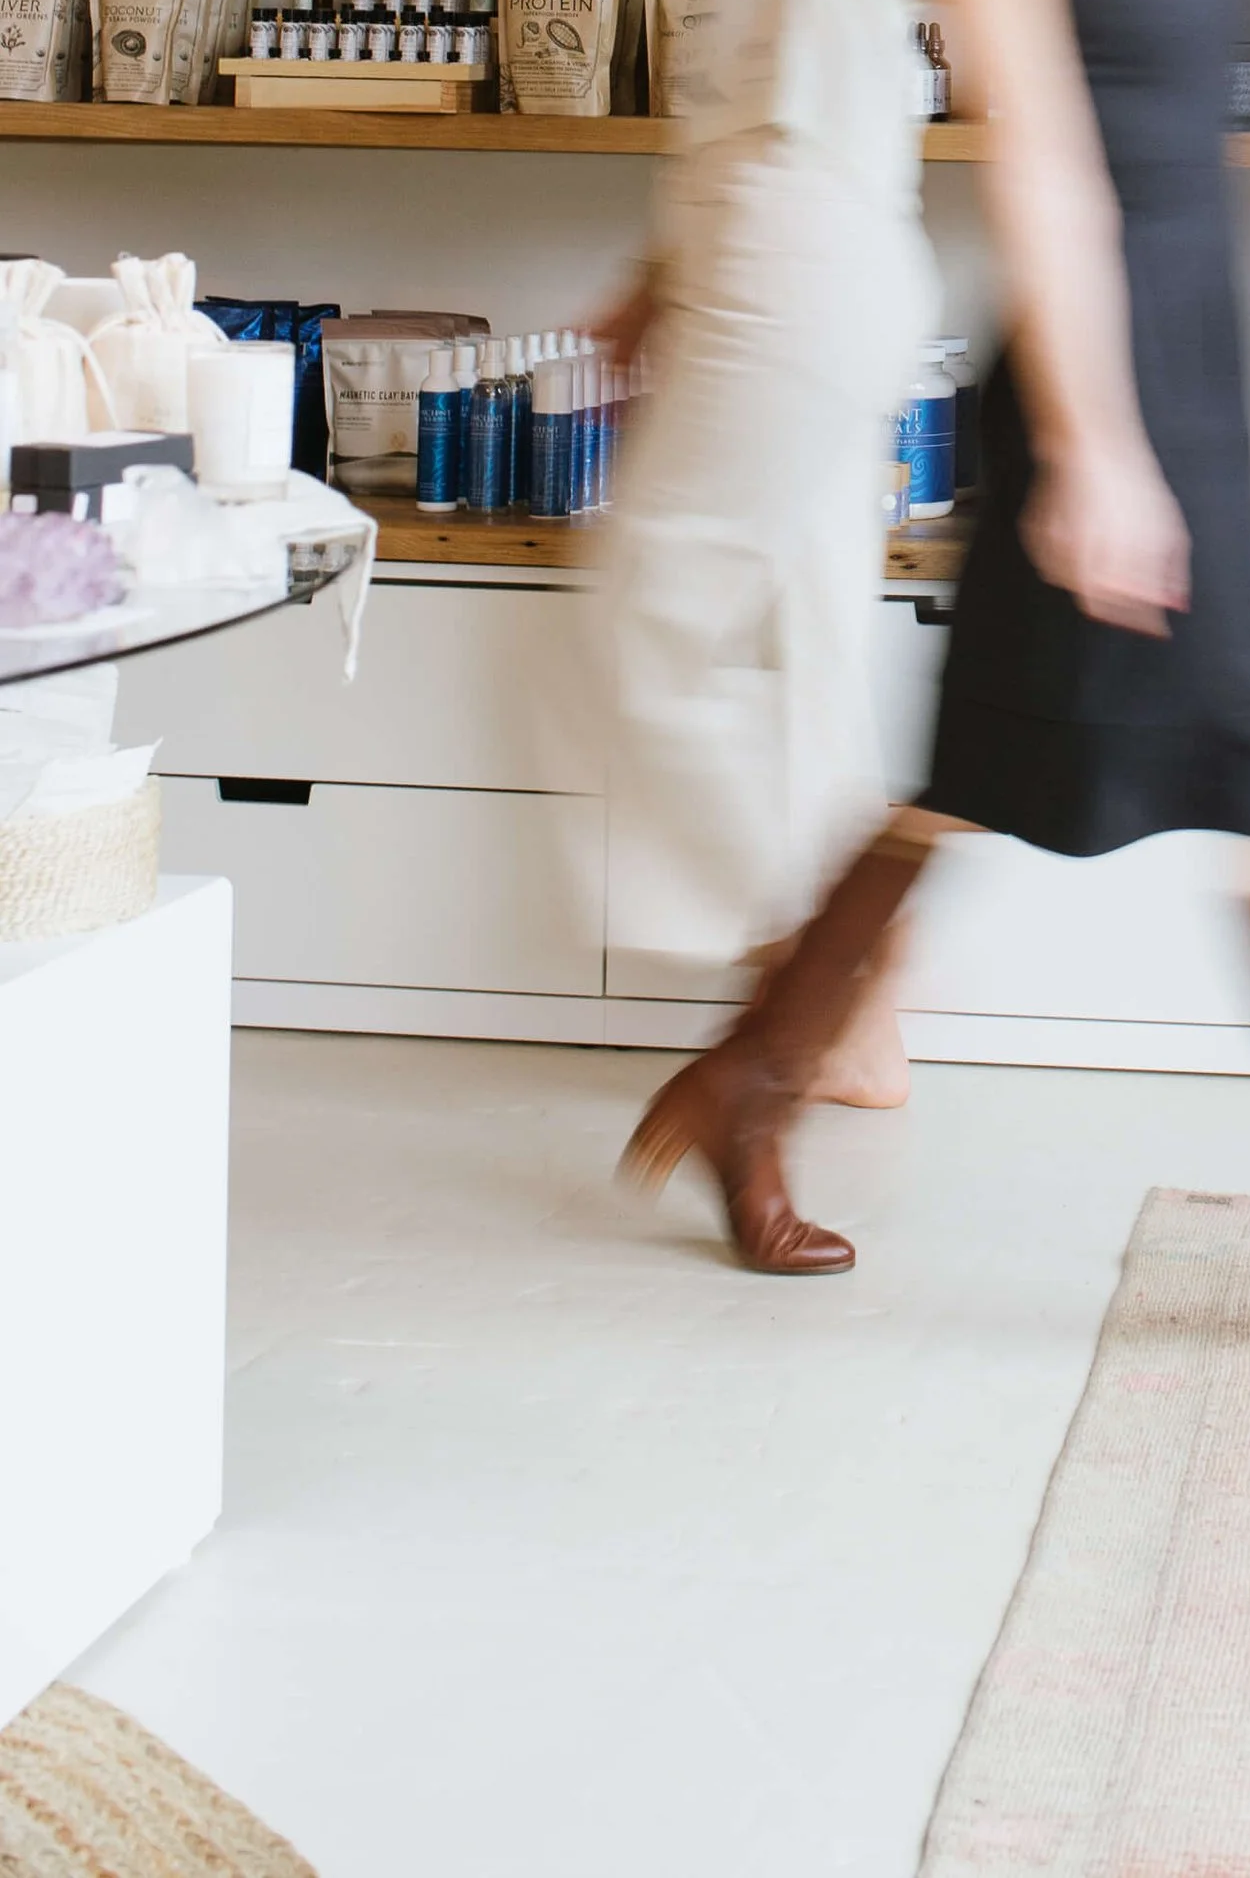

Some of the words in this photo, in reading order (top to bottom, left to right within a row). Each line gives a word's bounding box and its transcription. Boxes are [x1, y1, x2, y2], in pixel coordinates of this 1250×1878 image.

[0, 0, 41, 12] IVER
[339, 391, 376, 401] MAGNETIC
[378, 391, 397, 400] CLAY
